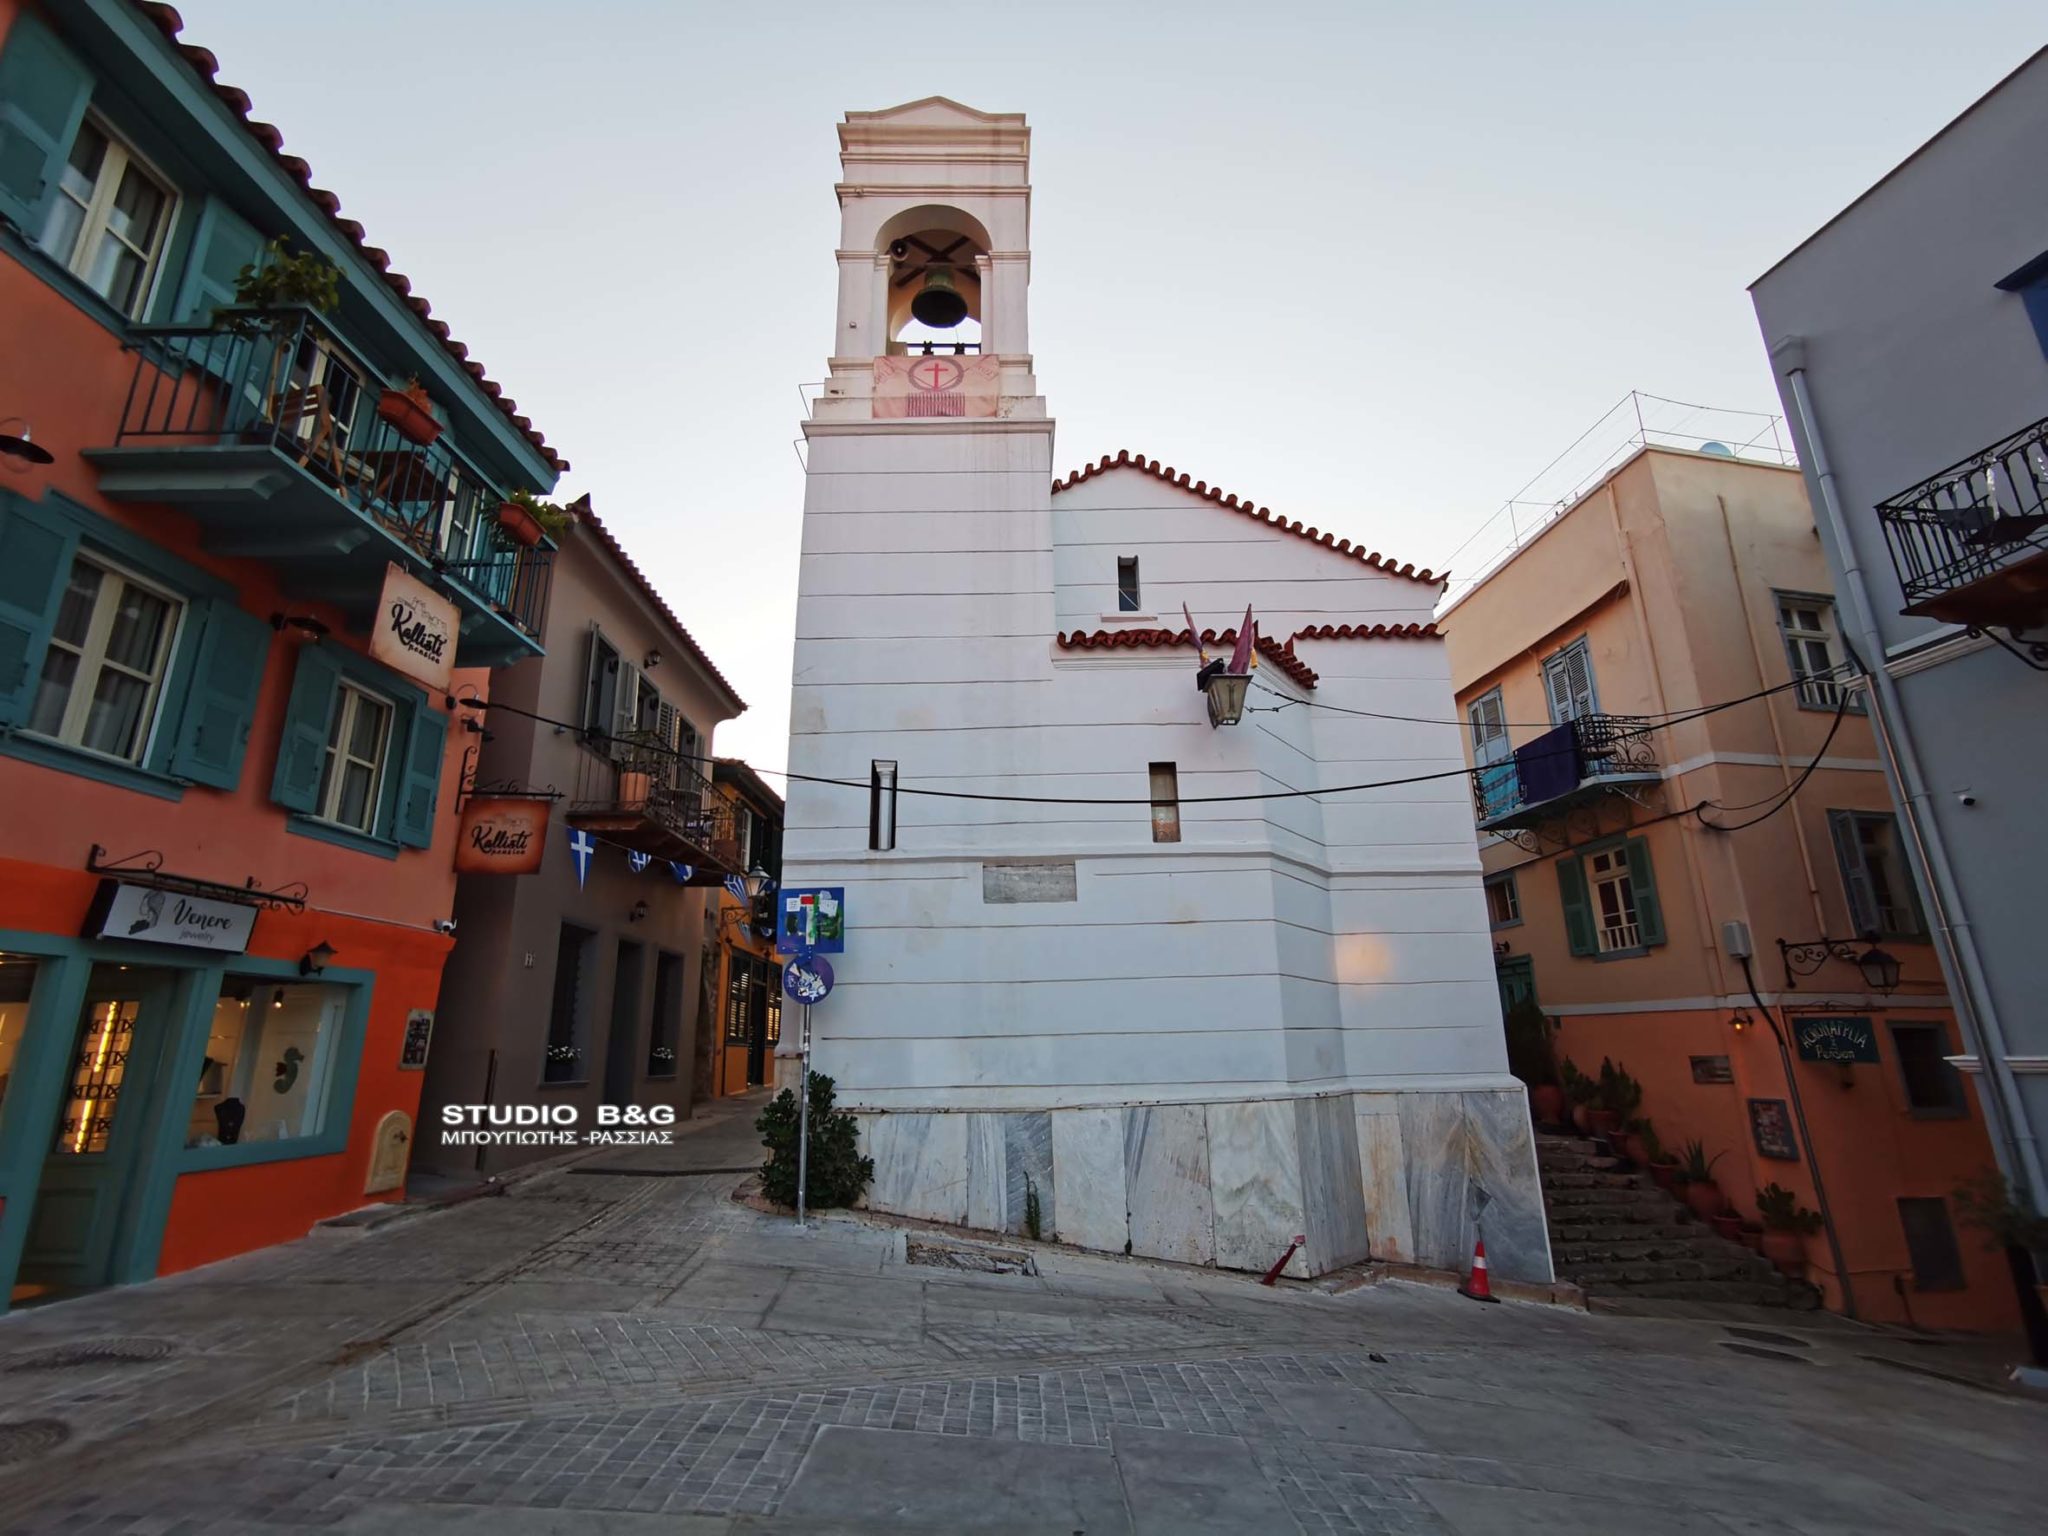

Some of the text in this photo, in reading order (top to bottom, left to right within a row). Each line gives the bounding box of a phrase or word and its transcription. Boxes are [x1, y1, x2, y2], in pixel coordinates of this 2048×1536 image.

[391, 603, 448, 658] Kallisti
[471, 825, 533, 854] Kallisti
[173, 898, 233, 930] Venere
